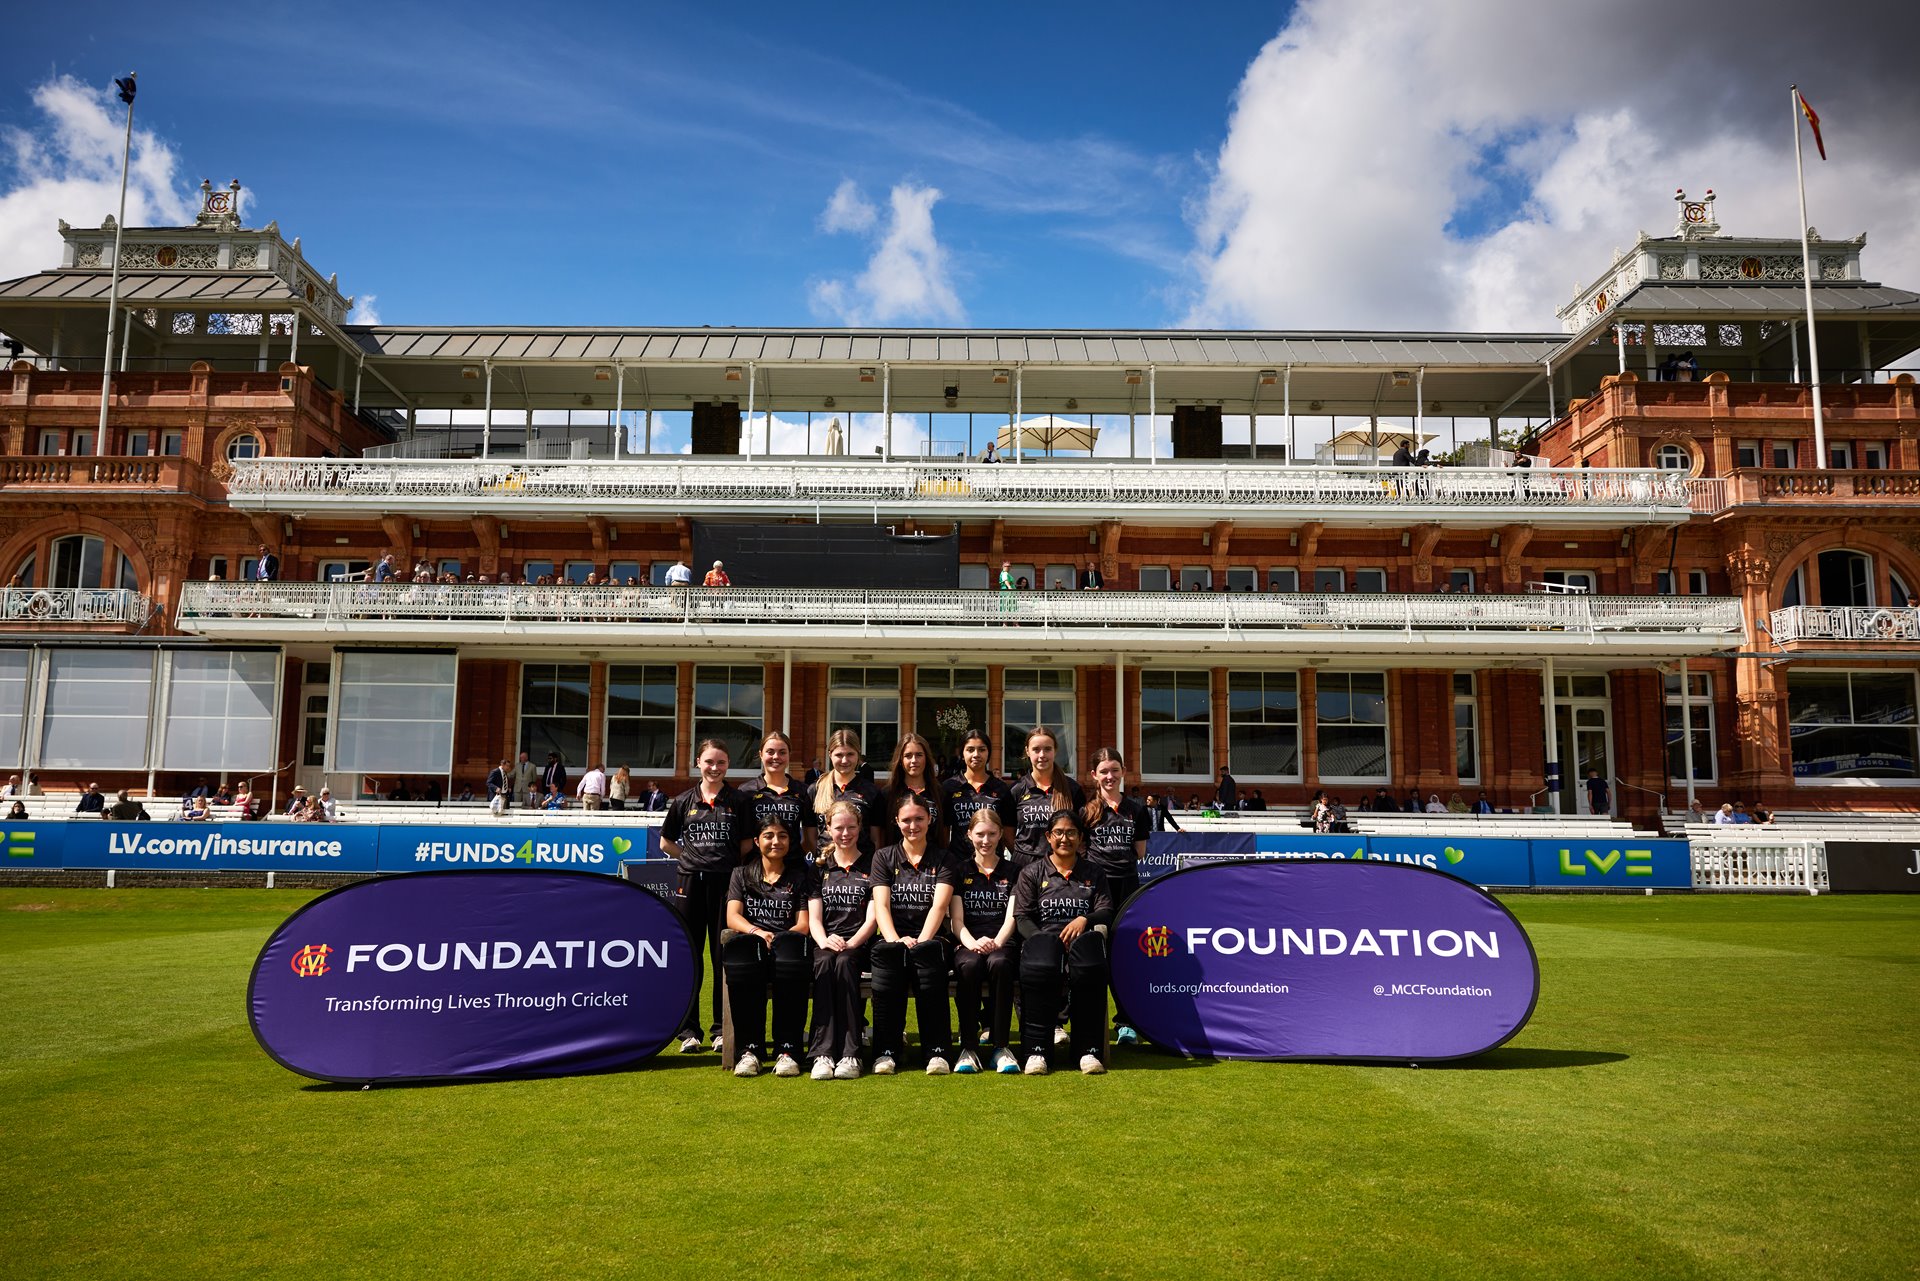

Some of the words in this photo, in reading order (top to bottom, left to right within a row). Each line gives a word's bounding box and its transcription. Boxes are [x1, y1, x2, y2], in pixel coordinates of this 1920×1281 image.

[755, 803, 799, 812] CHARLES
[1023, 805, 1056, 814] CHARL
[756, 813, 799, 821] STLEY
[1023, 813, 1049, 823] STAN
[688, 822, 731, 832] CHARLES
[689, 831, 730, 842] STANLEY
[108, 832, 342, 860] LV.com/insurance
[415, 839, 604, 864] #FUNDS4RUNS
[821, 886, 866, 896] CHARLES
[891, 883, 936, 893] CHARLES
[823, 895, 864, 905] STANLEY
[964, 891, 1008, 900] CHARLES
[746, 898, 793, 909] CHARLES
[1041, 898, 1090, 908] CHARLES
[747, 908, 791, 918] STANLEY
[1186, 926, 1500, 959] FOUNDATION
[346, 939, 668, 973] FOUNDATION
[1149, 982, 1289, 996] lords.org/mccfoundation
[1373, 984, 1492, 997] @_MCCFoundation
[325, 995, 442, 1014] Transforming
[448, 994, 491, 1009] Lives
[495, 992, 567, 1011] Through
[571, 991, 628, 1007] Cricket
